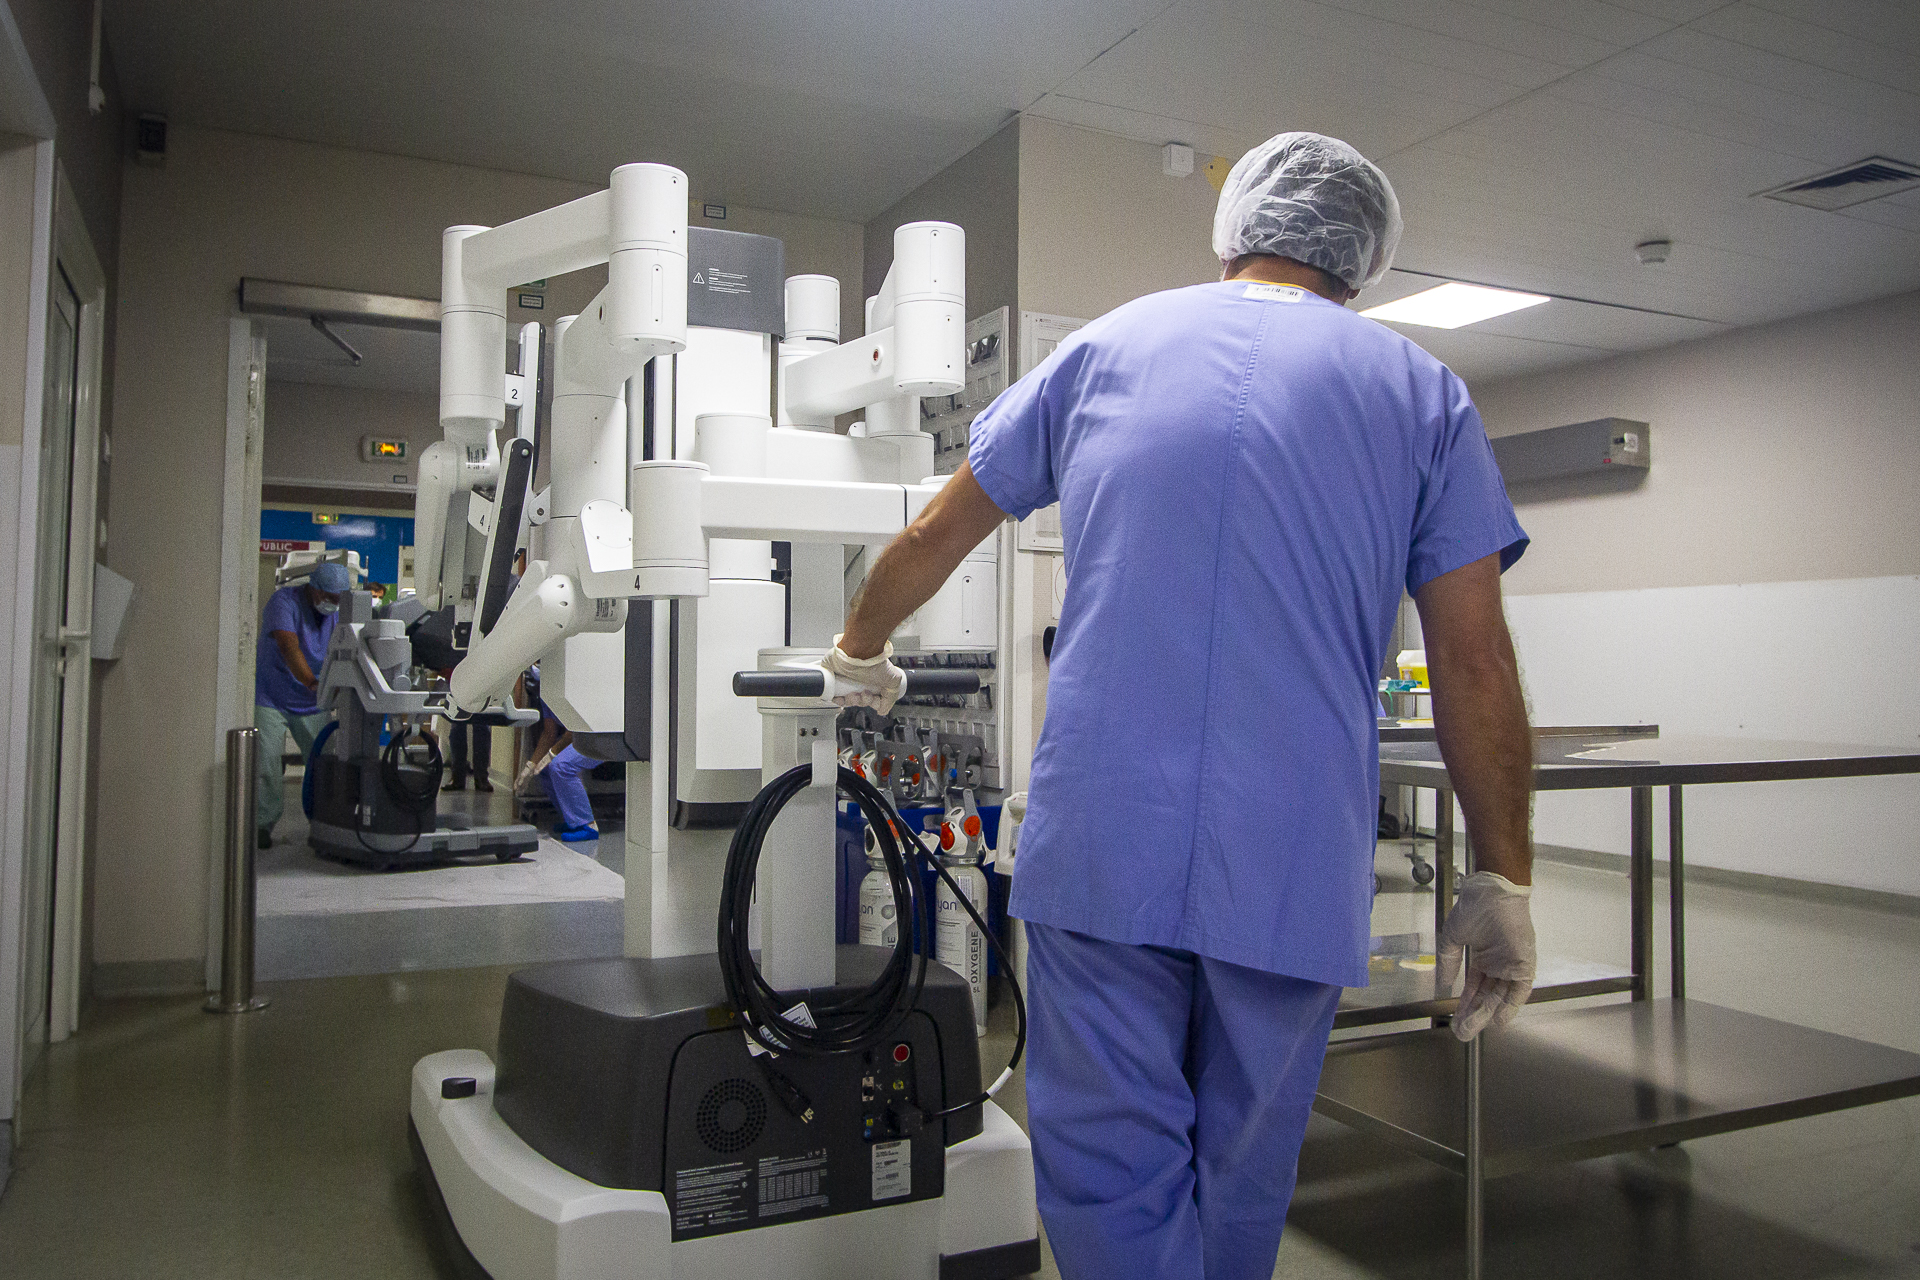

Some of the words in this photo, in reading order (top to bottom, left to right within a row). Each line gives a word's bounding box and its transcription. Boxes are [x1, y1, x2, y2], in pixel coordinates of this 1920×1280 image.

[511, 388, 518, 400] 2
[480, 514, 485, 527] 4
[634, 574, 641, 591] 4
[970, 930, 979, 984] OXYGENE
